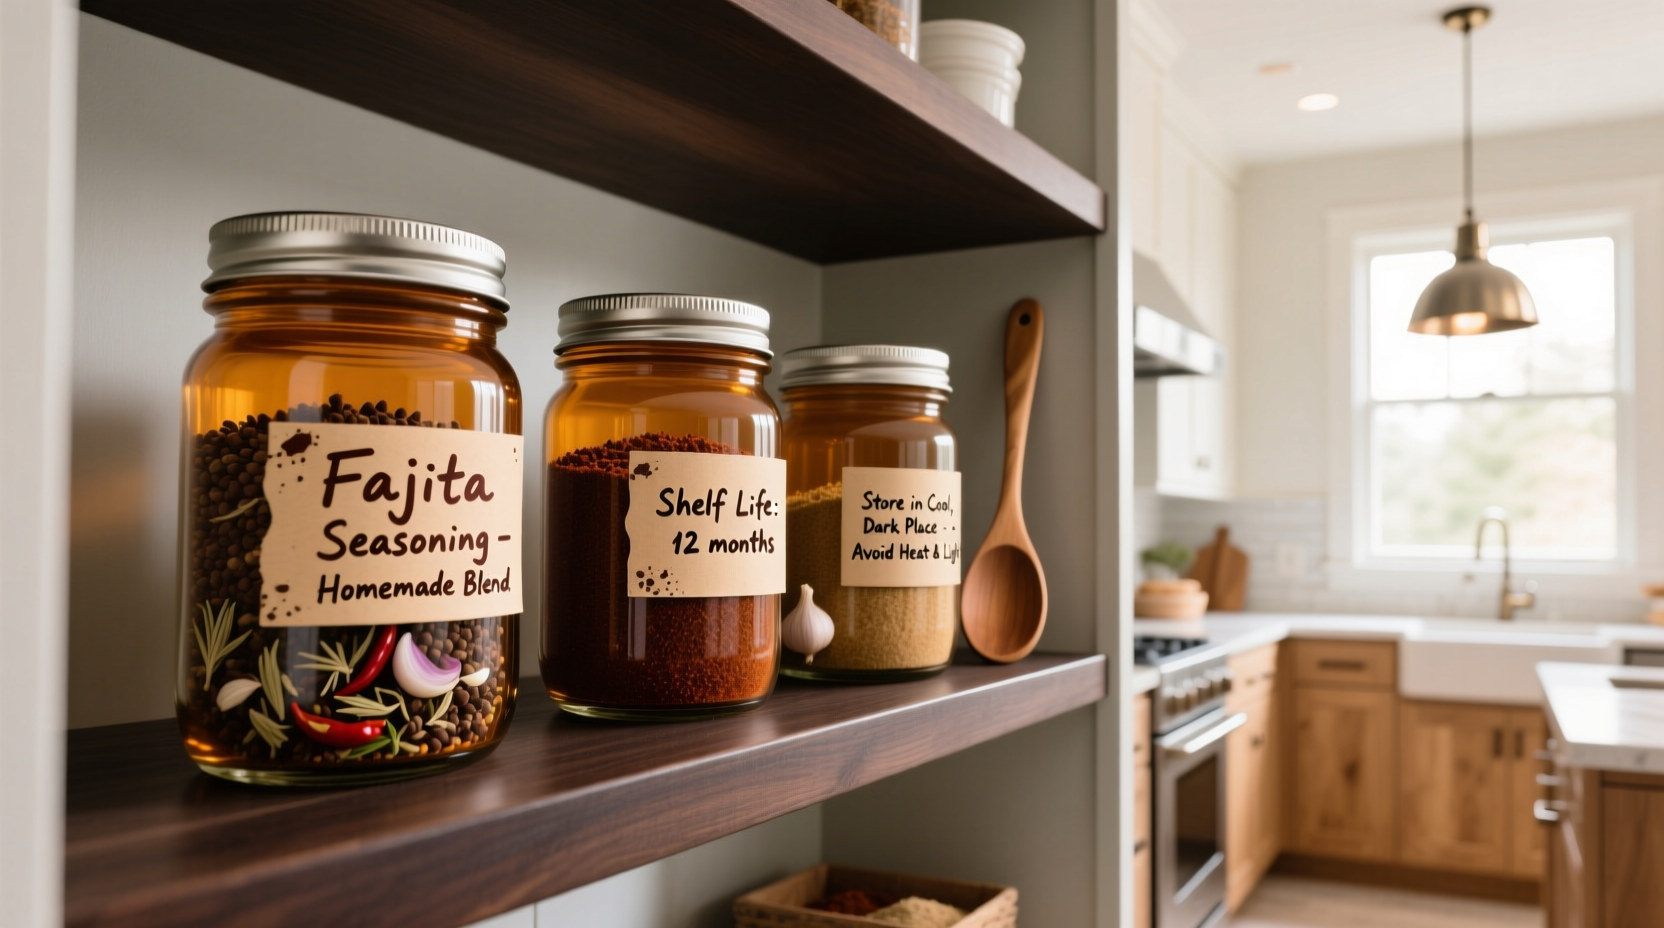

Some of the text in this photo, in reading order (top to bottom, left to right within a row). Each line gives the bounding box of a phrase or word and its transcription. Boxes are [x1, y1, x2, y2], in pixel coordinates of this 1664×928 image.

[322, 448, 494, 525] Fajita
[655, 487, 778, 523] Shelf Life:
[861, 490, 954, 517] Store in Cool,
[863, 516, 900, 534] Dark
[905, 516, 937, 535] Place
[317, 519, 489, 567] Seasoning
[672, 528, 775, 555] 12 months
[851, 542, 894, 560] Avoid
[899, 542, 930, 560] Heat
[317, 566, 511, 604] Homemade Blend
